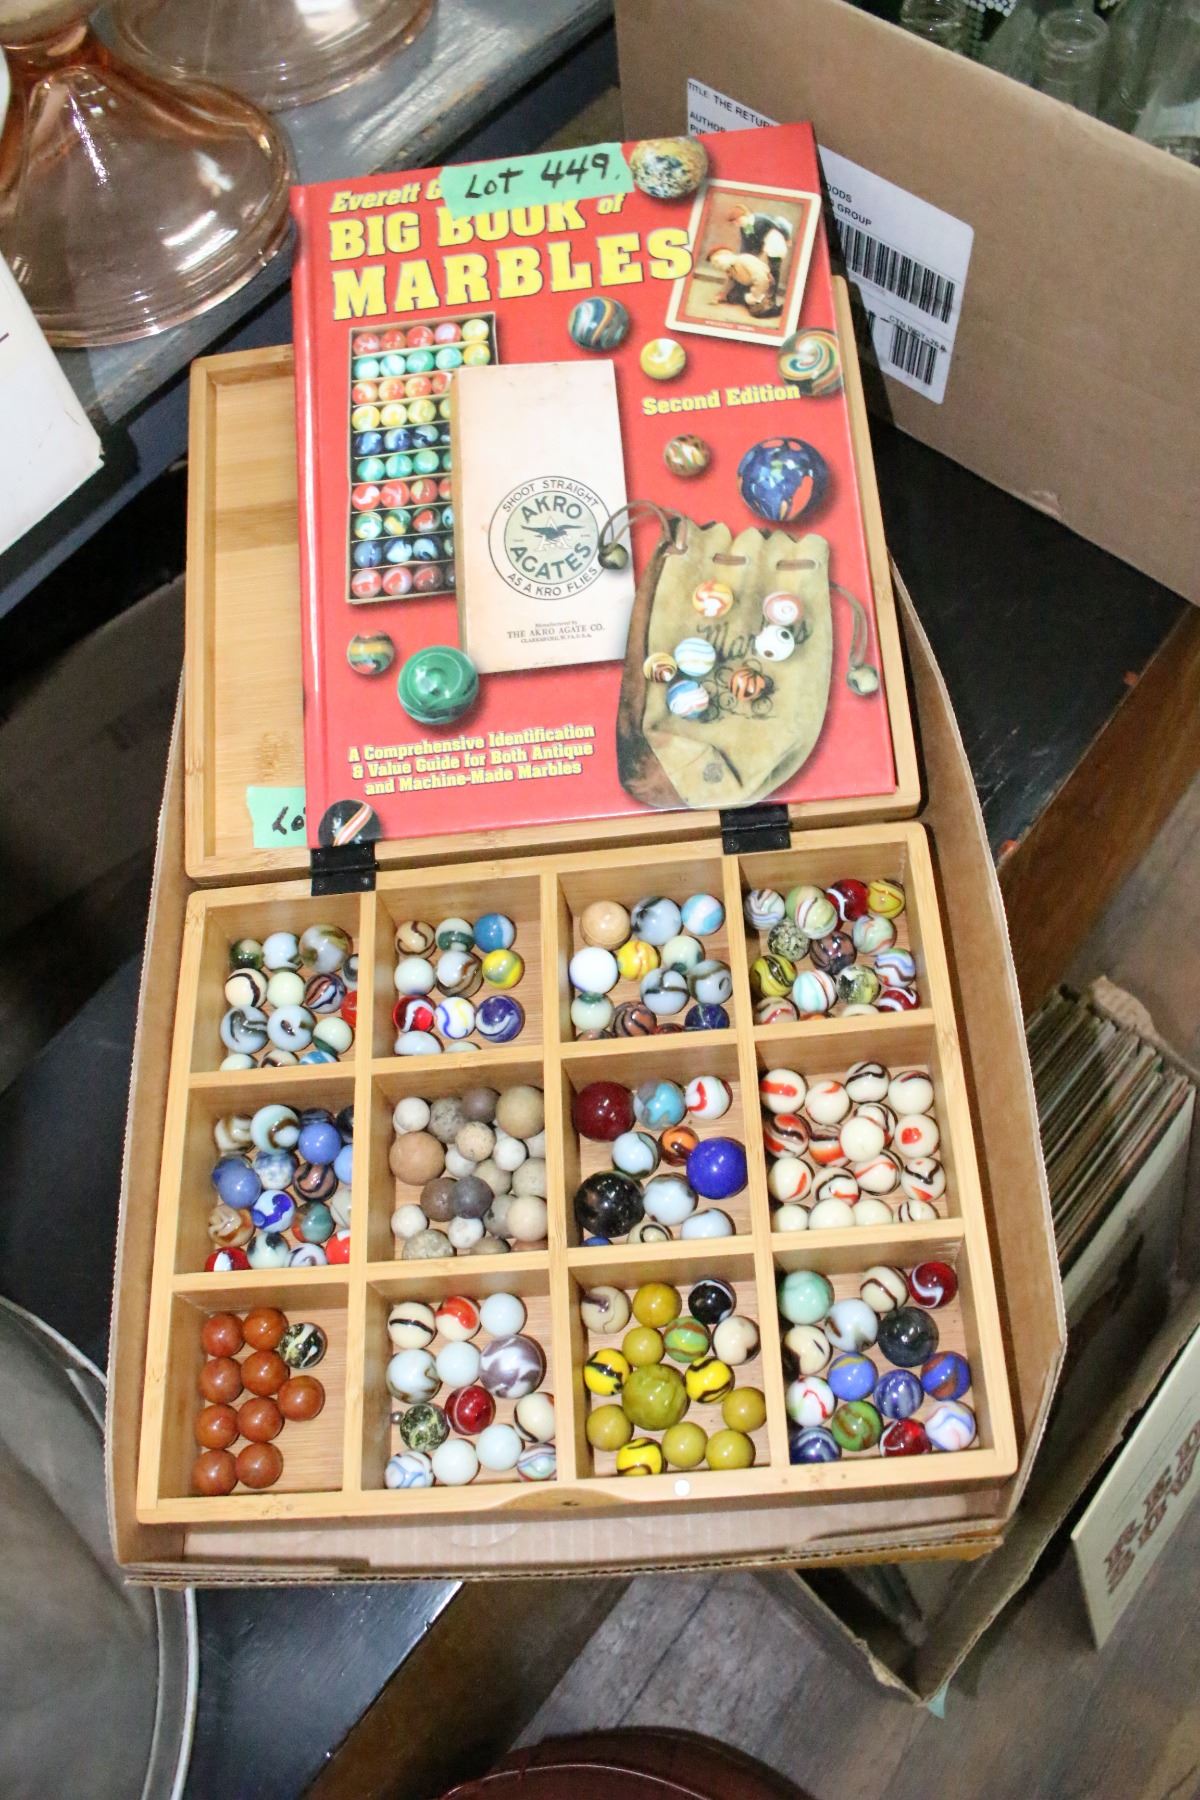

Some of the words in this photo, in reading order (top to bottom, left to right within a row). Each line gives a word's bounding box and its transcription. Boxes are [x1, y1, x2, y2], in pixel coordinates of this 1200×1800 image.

[714, 95, 733, 112] THE
[736, 107, 774, 128] RETUR
[329, 182, 421, 214] Everett
[837, 203, 872, 226] GROUP
[328, 211, 421, 261] BIG
[596, 193, 627, 215] of
[331, 226, 693, 321] MARBLES
[642, 389, 721, 416] Second
[725, 384, 801, 407] Edition
[503, 483, 536, 512] SHOOT
[543, 479, 599, 507] STRAIGHT
[521, 495, 583, 524] AKRO
[510, 542, 592, 580] AGATES
[508, 573, 523, 586] AS
[523, 583, 532, 593] A
[535, 586, 562, 597] KRO
[567, 567, 598, 593] FLIES
[507, 630, 526, 640] THE
[530, 627, 555, 637] AKRO
[559, 624, 586, 635] AGATE
[348, 747, 360, 763] A
[364, 736, 486, 761] Comprehensive
[488, 724, 595, 747] Identification
[352, 764, 364, 780] &
[367, 760, 412, 778] Value
[415, 754, 460, 773] Guide
[464, 751, 486, 769] for
[490, 747, 528, 765] Both
[531, 742, 594, 761] Antique
[365, 779, 395, 796] and
[399, 766, 514, 792] Machine-Made
[517, 760, 583, 781] Marbles
[272, 806, 306, 835] Lo
